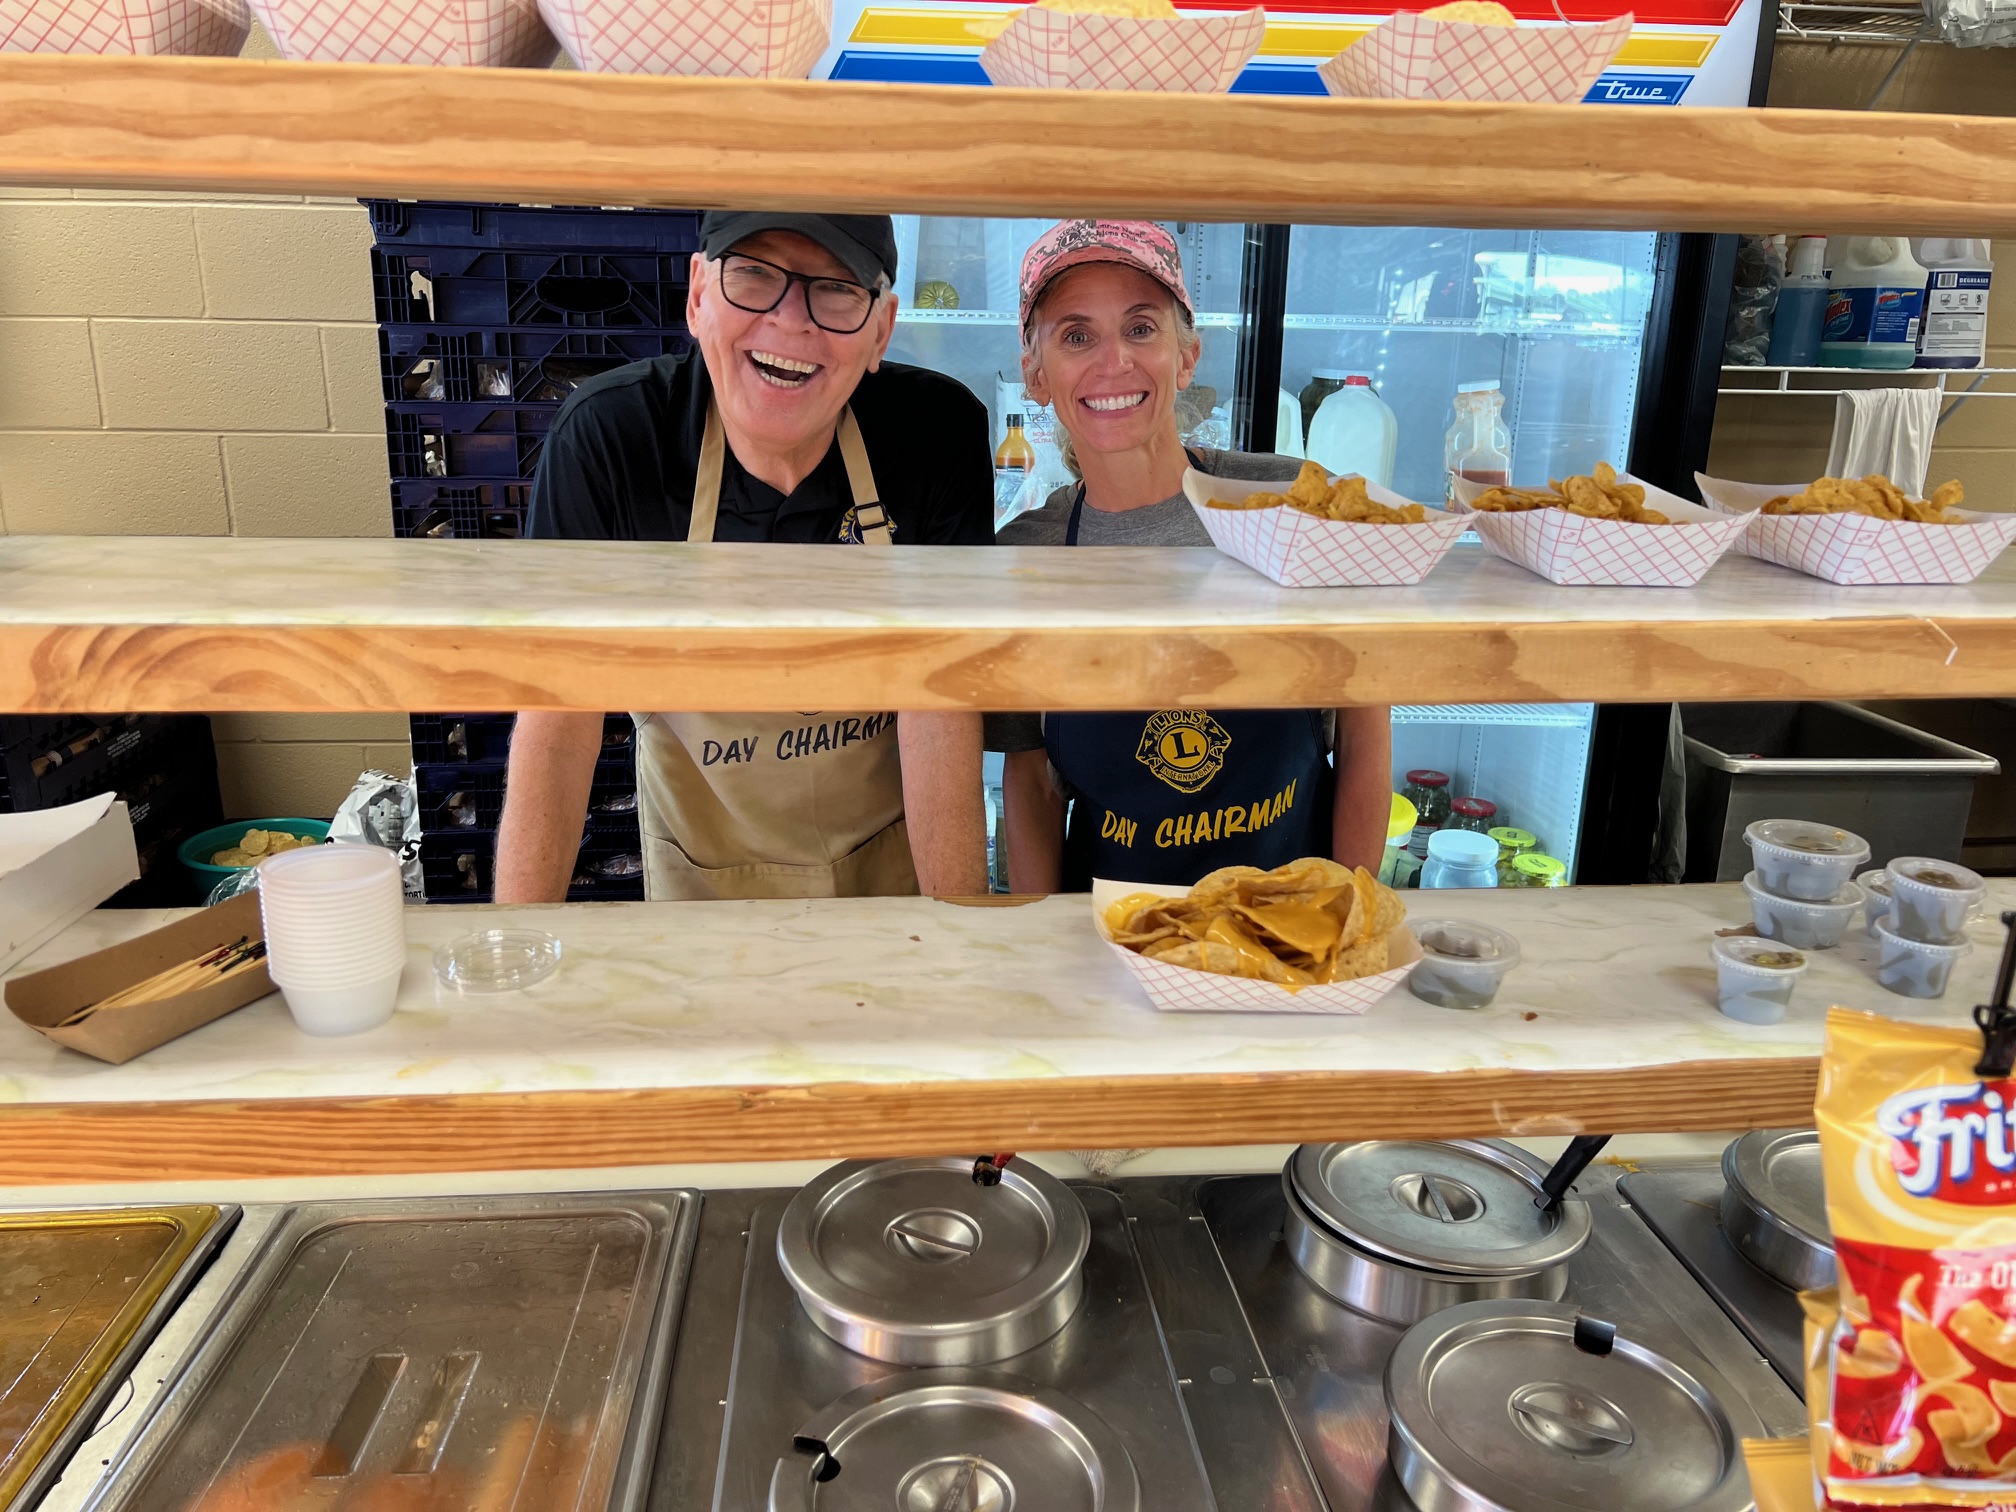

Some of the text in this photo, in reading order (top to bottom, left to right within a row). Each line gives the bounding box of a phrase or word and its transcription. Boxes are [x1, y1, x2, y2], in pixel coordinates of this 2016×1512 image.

[1596, 80, 1668, 100] true
[1121, 232, 1139, 242] Club
[1152, 709, 1203, 735] LIONS
[702, 711, 898, 767] DAY CHAIRMA
[1170, 731, 1200, 760] L
[1159, 760, 1216, 781] INTERNATIONAL
[1101, 778, 1297, 848] DAY CHAIRMAN
[1938, 1264, 1983, 1289] The
